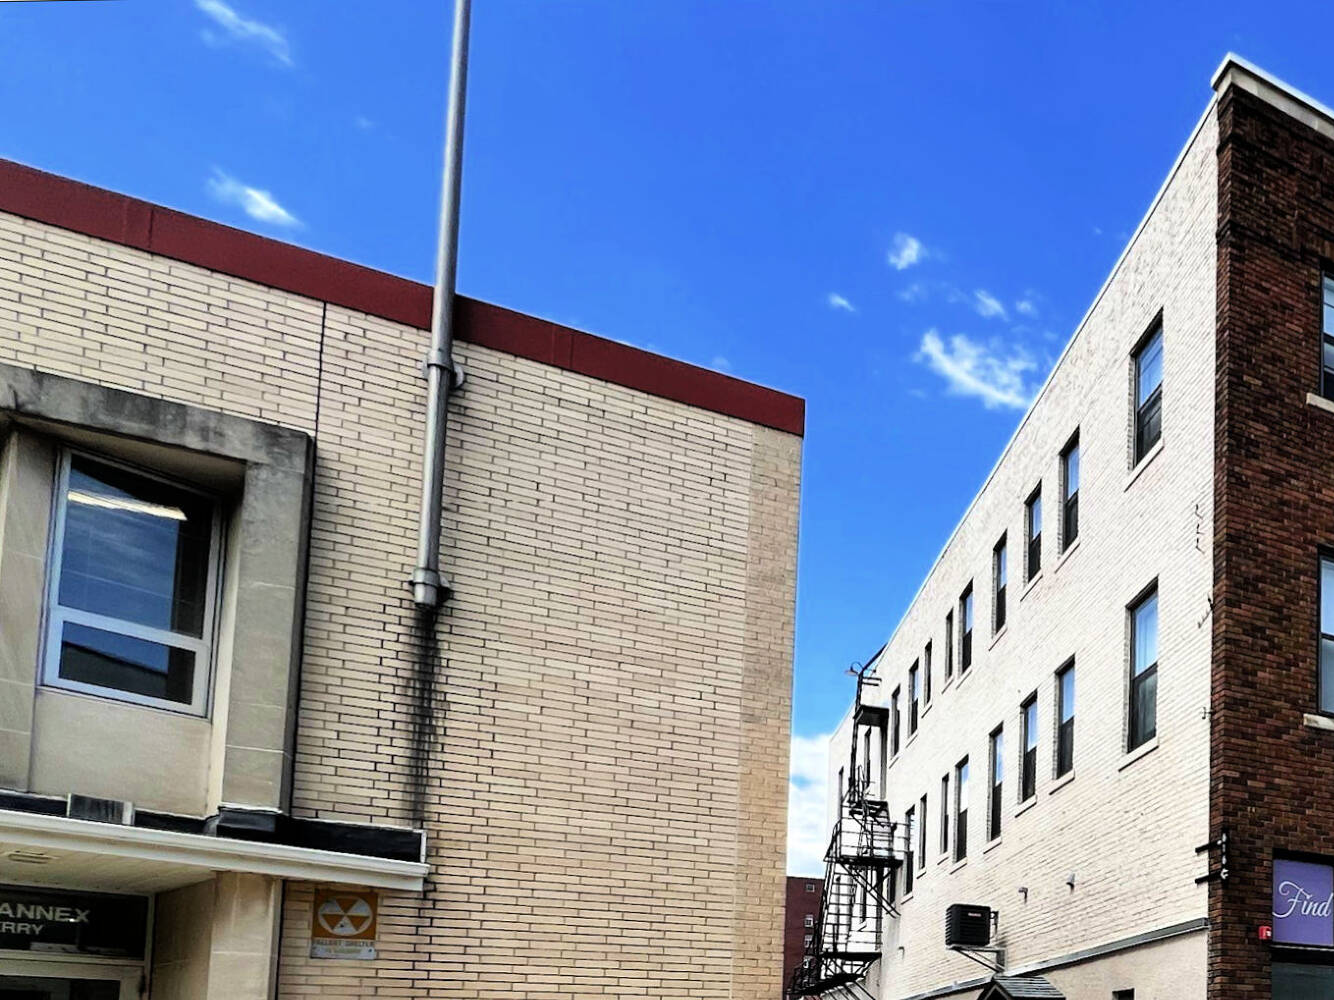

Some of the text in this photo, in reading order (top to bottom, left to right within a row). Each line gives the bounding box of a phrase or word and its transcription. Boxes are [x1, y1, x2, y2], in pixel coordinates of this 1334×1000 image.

[1272, 881, 1334, 918] Find
[0, 902, 91, 922] ANNEX
[0, 921, 44, 935] RRY
